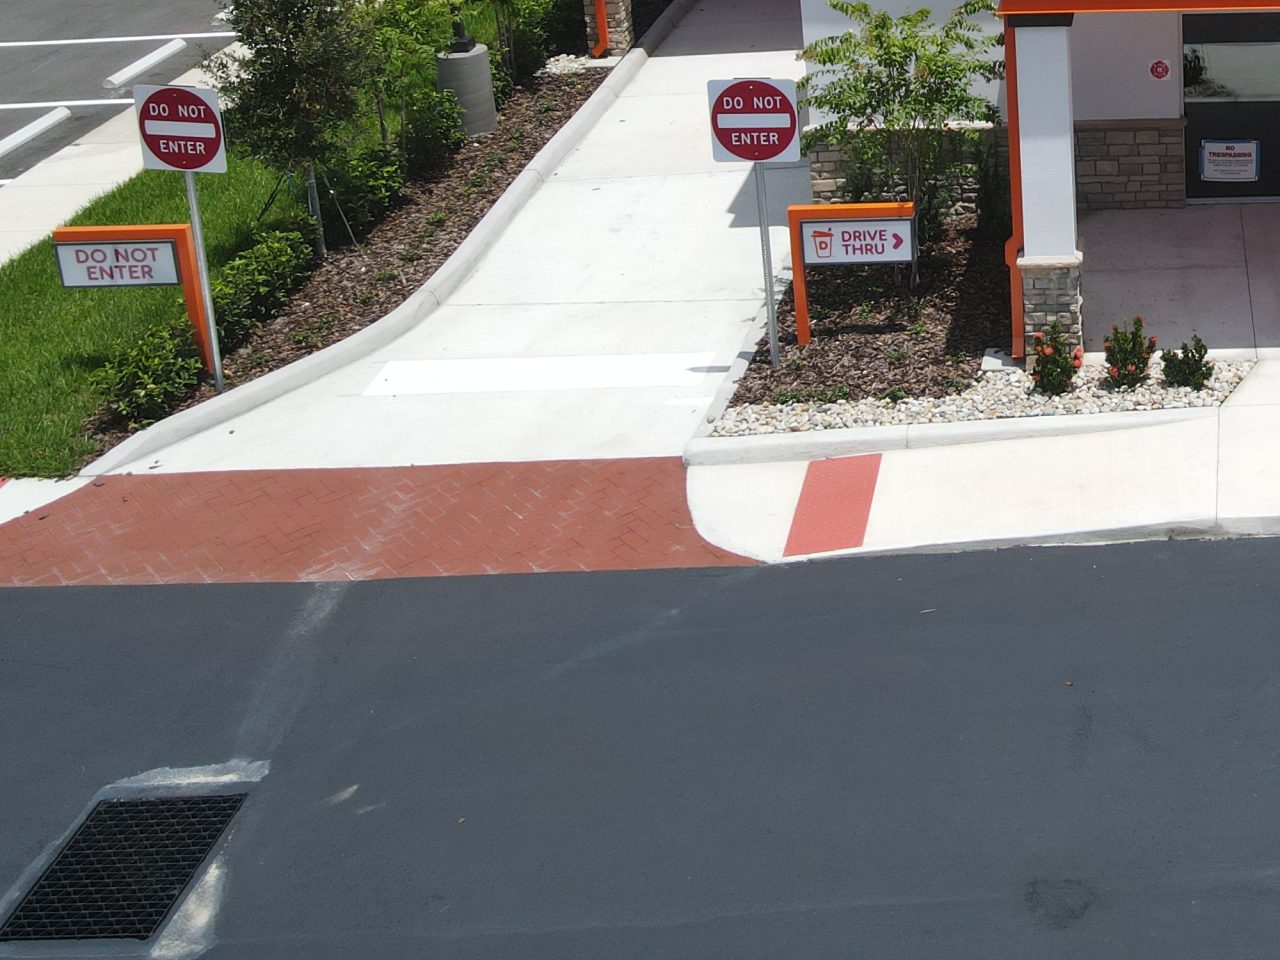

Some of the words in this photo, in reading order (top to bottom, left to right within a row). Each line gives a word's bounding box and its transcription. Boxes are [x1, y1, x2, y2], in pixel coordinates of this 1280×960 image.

[723, 97, 743, 109] DO
[753, 96, 782, 109] NOT
[149, 103, 169, 117] DO
[178, 105, 205, 119] NOT
[731, 133, 779, 145] ENTER
[160, 140, 206, 155] ENTER
[841, 230, 887, 242] DRIVE
[75, 249, 107, 264] DO
[114, 248, 158, 263] NOT
[842, 243, 885, 255] THRU
[87, 265, 154, 280] ENTER
